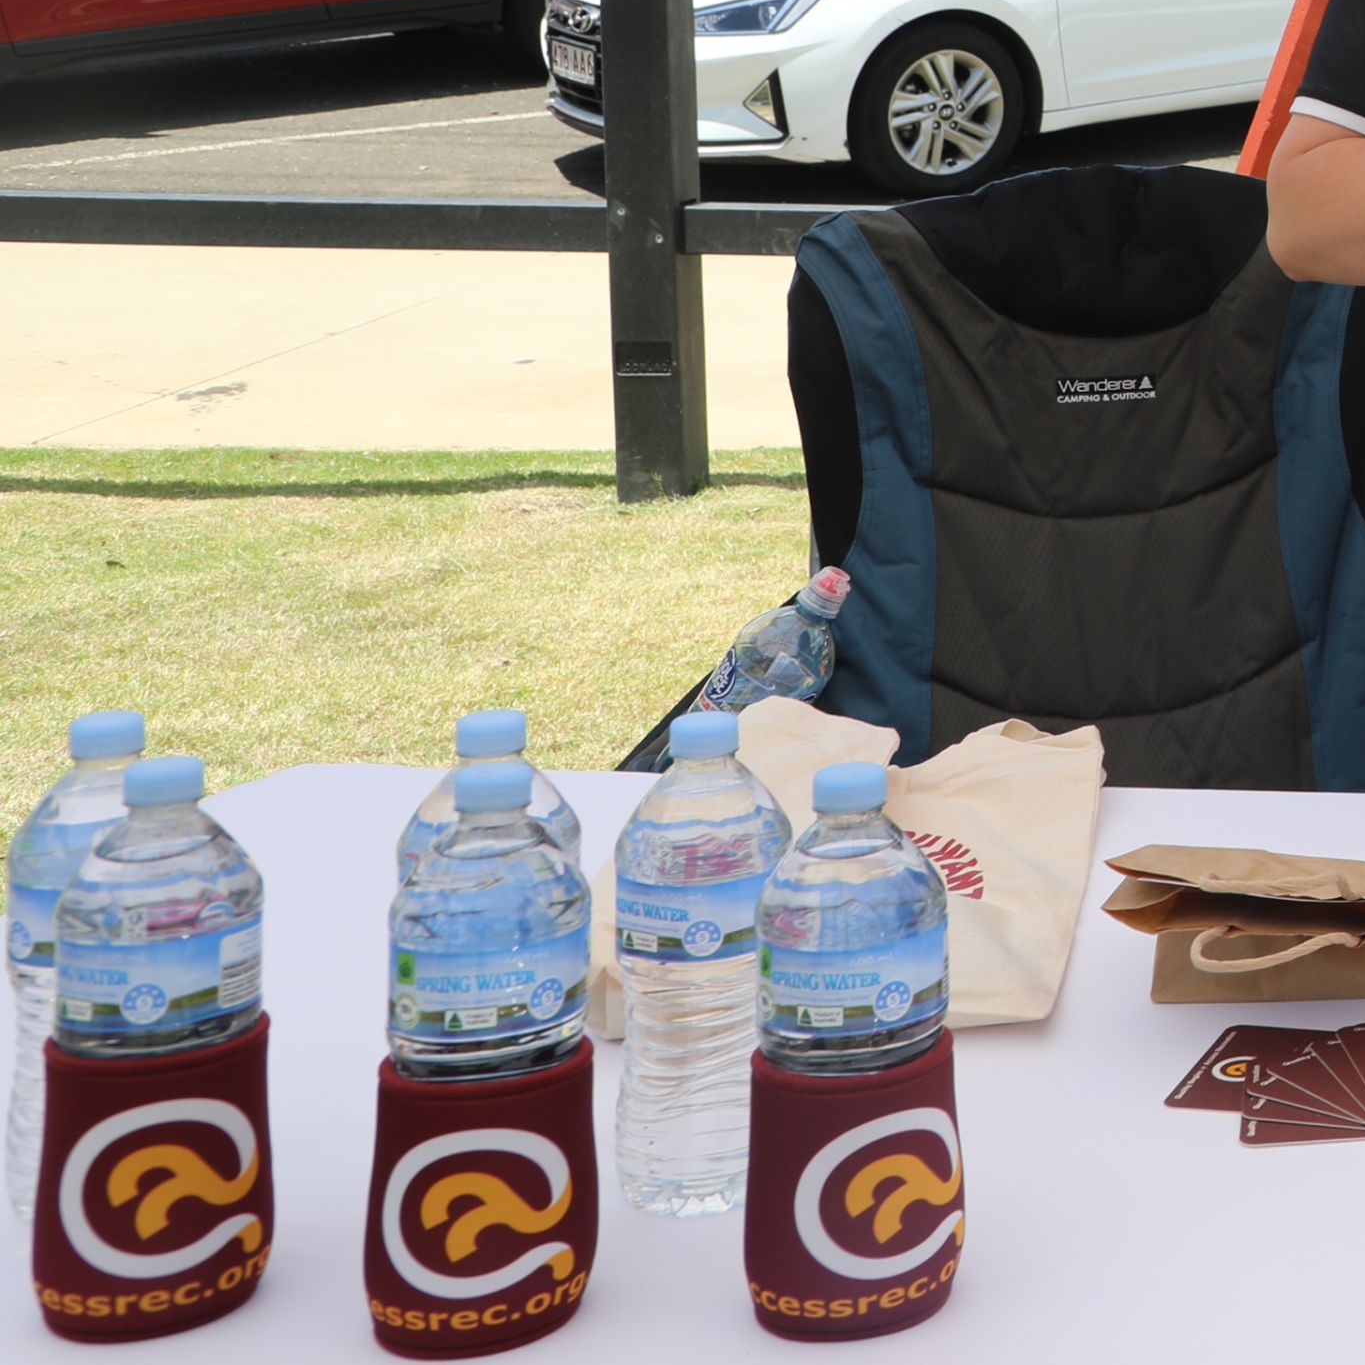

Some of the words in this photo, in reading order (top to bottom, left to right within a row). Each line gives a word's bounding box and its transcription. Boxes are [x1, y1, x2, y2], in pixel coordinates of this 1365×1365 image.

[1057, 378, 1138, 394] Wanderer
[1057, 393, 1100, 404] CAMPING
[1103, 393, 1110, 402] &
[1111, 391, 1157, 402] OUTDOOR
[475, 969, 537, 991] WATER
[772, 971, 819, 990] SPRING
[822, 972, 881, 991] WATER
